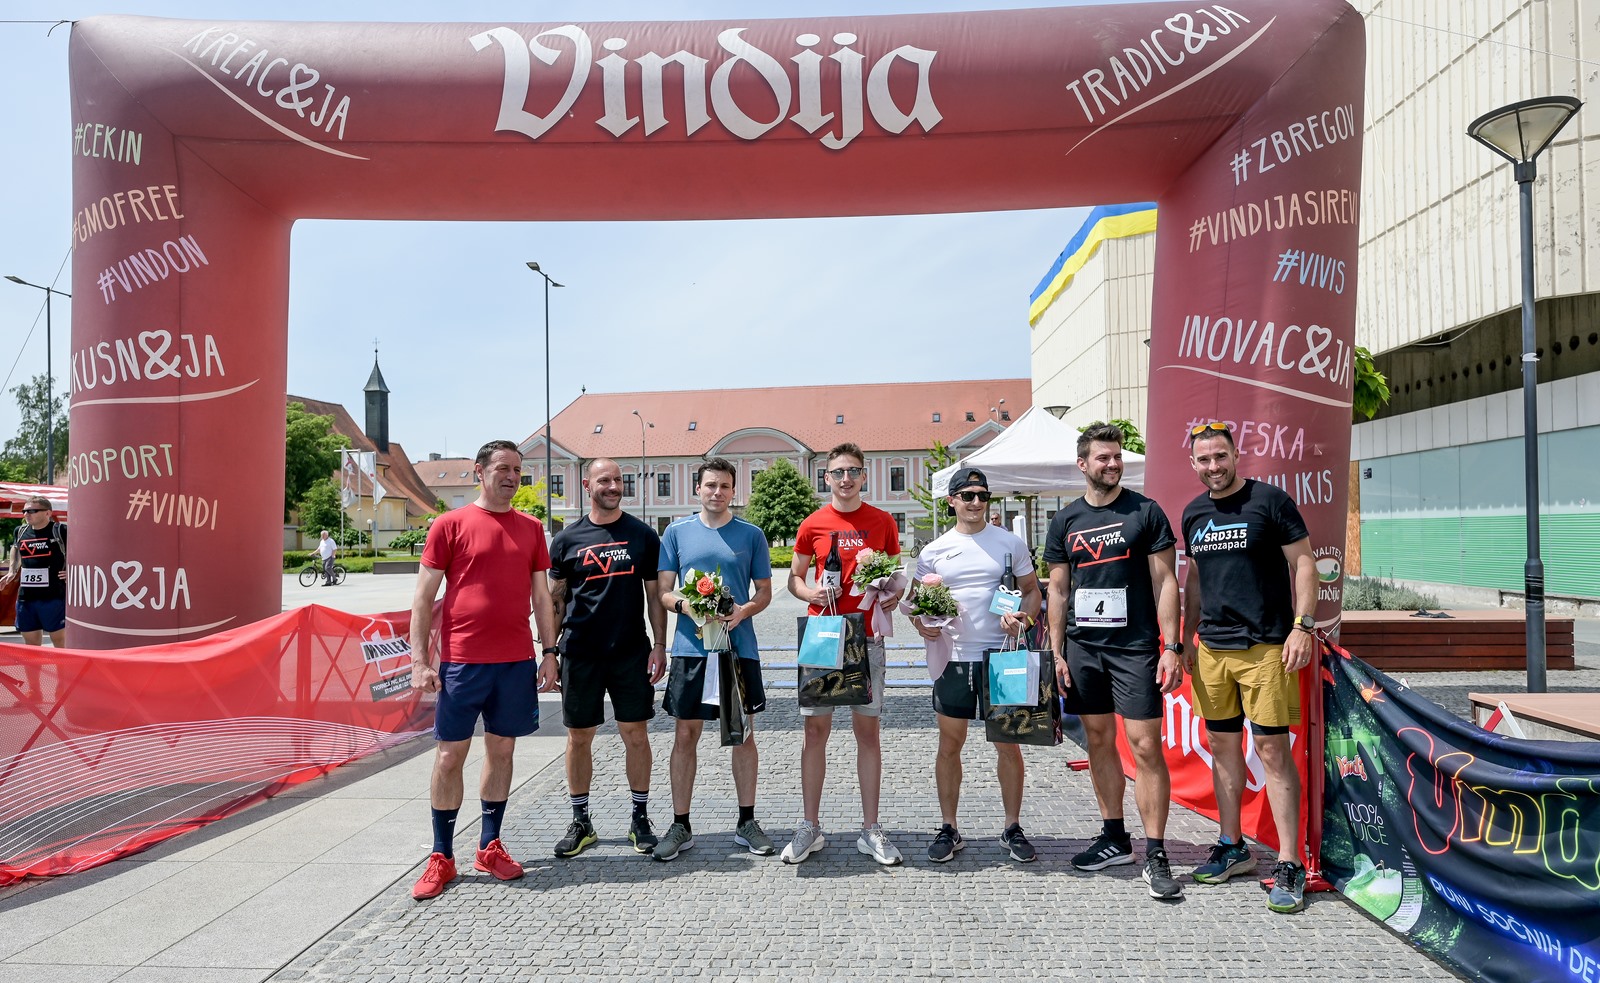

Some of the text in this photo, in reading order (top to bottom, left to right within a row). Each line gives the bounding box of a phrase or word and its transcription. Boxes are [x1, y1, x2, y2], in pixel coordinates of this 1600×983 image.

[1065, 4, 1250, 123] TRADIC&JA
[183, 26, 351, 140] KREAC&JA
[468, 24, 944, 150] Vindija
[74, 122, 142, 165] #CEKIN
[1229, 103, 1355, 186] #ZBREGOV
[97, 234, 209, 304] #VINDON
[1273, 248, 1346, 295] #VIVIS
[1178, 315, 1351, 389] INOVAC&JA
[126, 488, 218, 530] #VINDI
[828, 529, 870, 540] OMMY
[838, 538, 863, 547] EANS
[1090, 531, 1121, 543] ACTIVE
[1105, 537, 1125, 546] VITA
[1204, 529, 1247, 542] SRD315
[599, 549, 627, 558] ACTIVE
[1094, 600, 1105, 616] 4
[363, 639, 411, 660] MARLEX
[1344, 803, 1384, 826] 100%
[1353, 823, 1389, 845] JUICE
[1430, 876, 1474, 914] PUNI
[1477, 904, 1562, 962] SOČNIH
